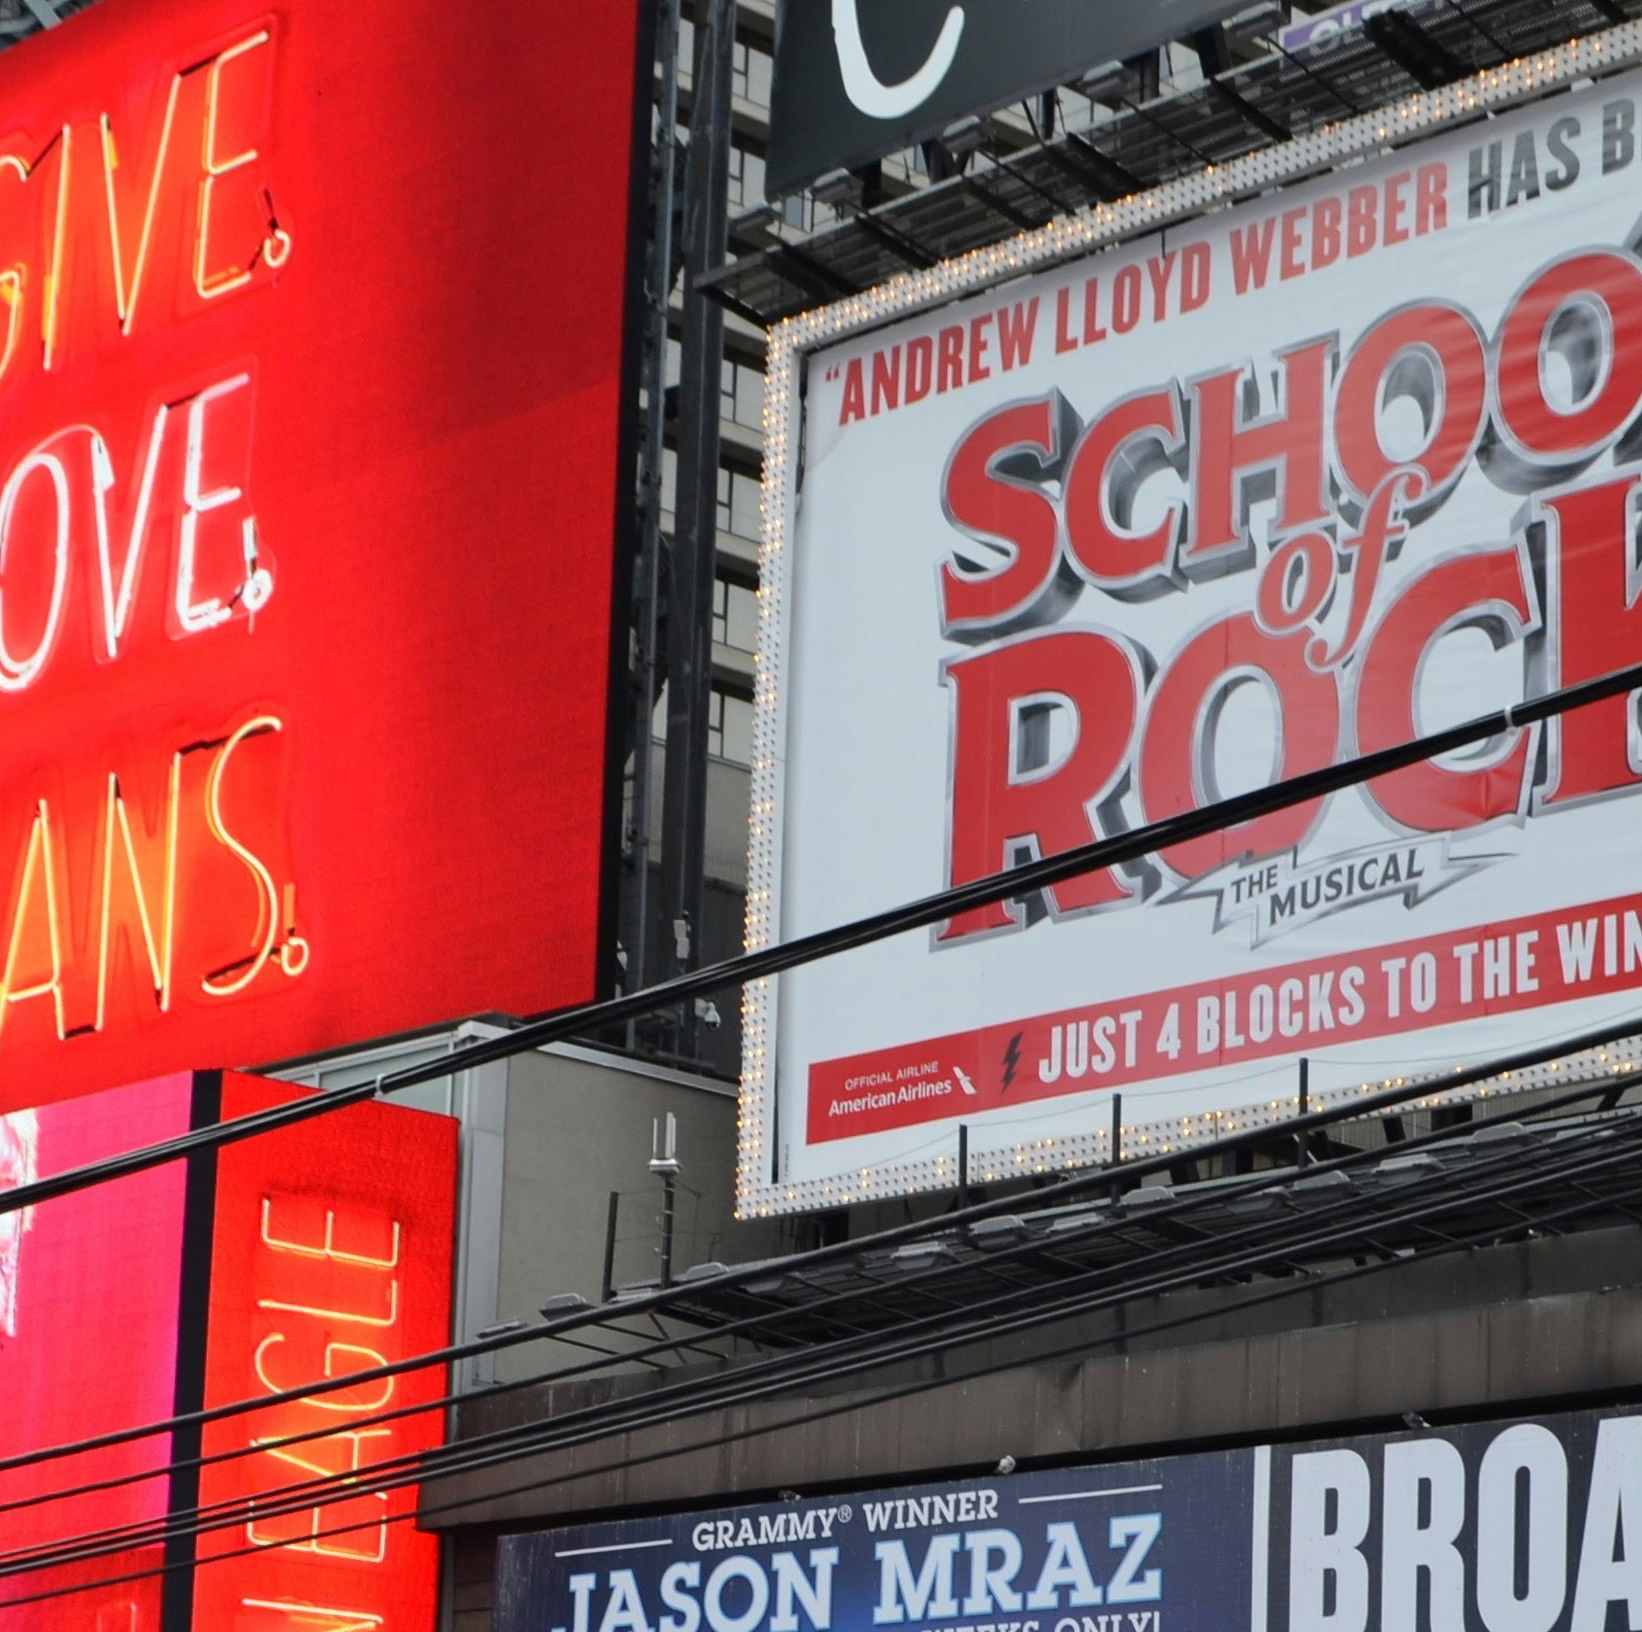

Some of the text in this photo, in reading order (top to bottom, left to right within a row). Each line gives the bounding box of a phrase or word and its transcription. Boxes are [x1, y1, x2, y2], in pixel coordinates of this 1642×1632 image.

[1055, 241, 1211, 357] LLOYD
[1229, 161, 1448, 294] WEBBER
[1467, 117, 1580, 219] HAS
[1254, 466, 1430, 674] of
[1231, 848, 1424, 927] THE MUSICAL
[1038, 1010, 1142, 1085] JUST
[1158, 1003, 1181, 1060] 4
[1197, 966, 1365, 1054] BLOCKS
[1381, 951, 1436, 1018] TO
[1452, 930, 1539, 1002] THE
[828, 1079, 952, 1116] American Airlines
[844, 1061, 939, 1090] OFFICIAL AIRLINE
[246, 1197, 402, 1564] EAGLE
[864, 1489, 998, 1532] WINNER
[873, 1512, 1163, 1626] MRAZ
